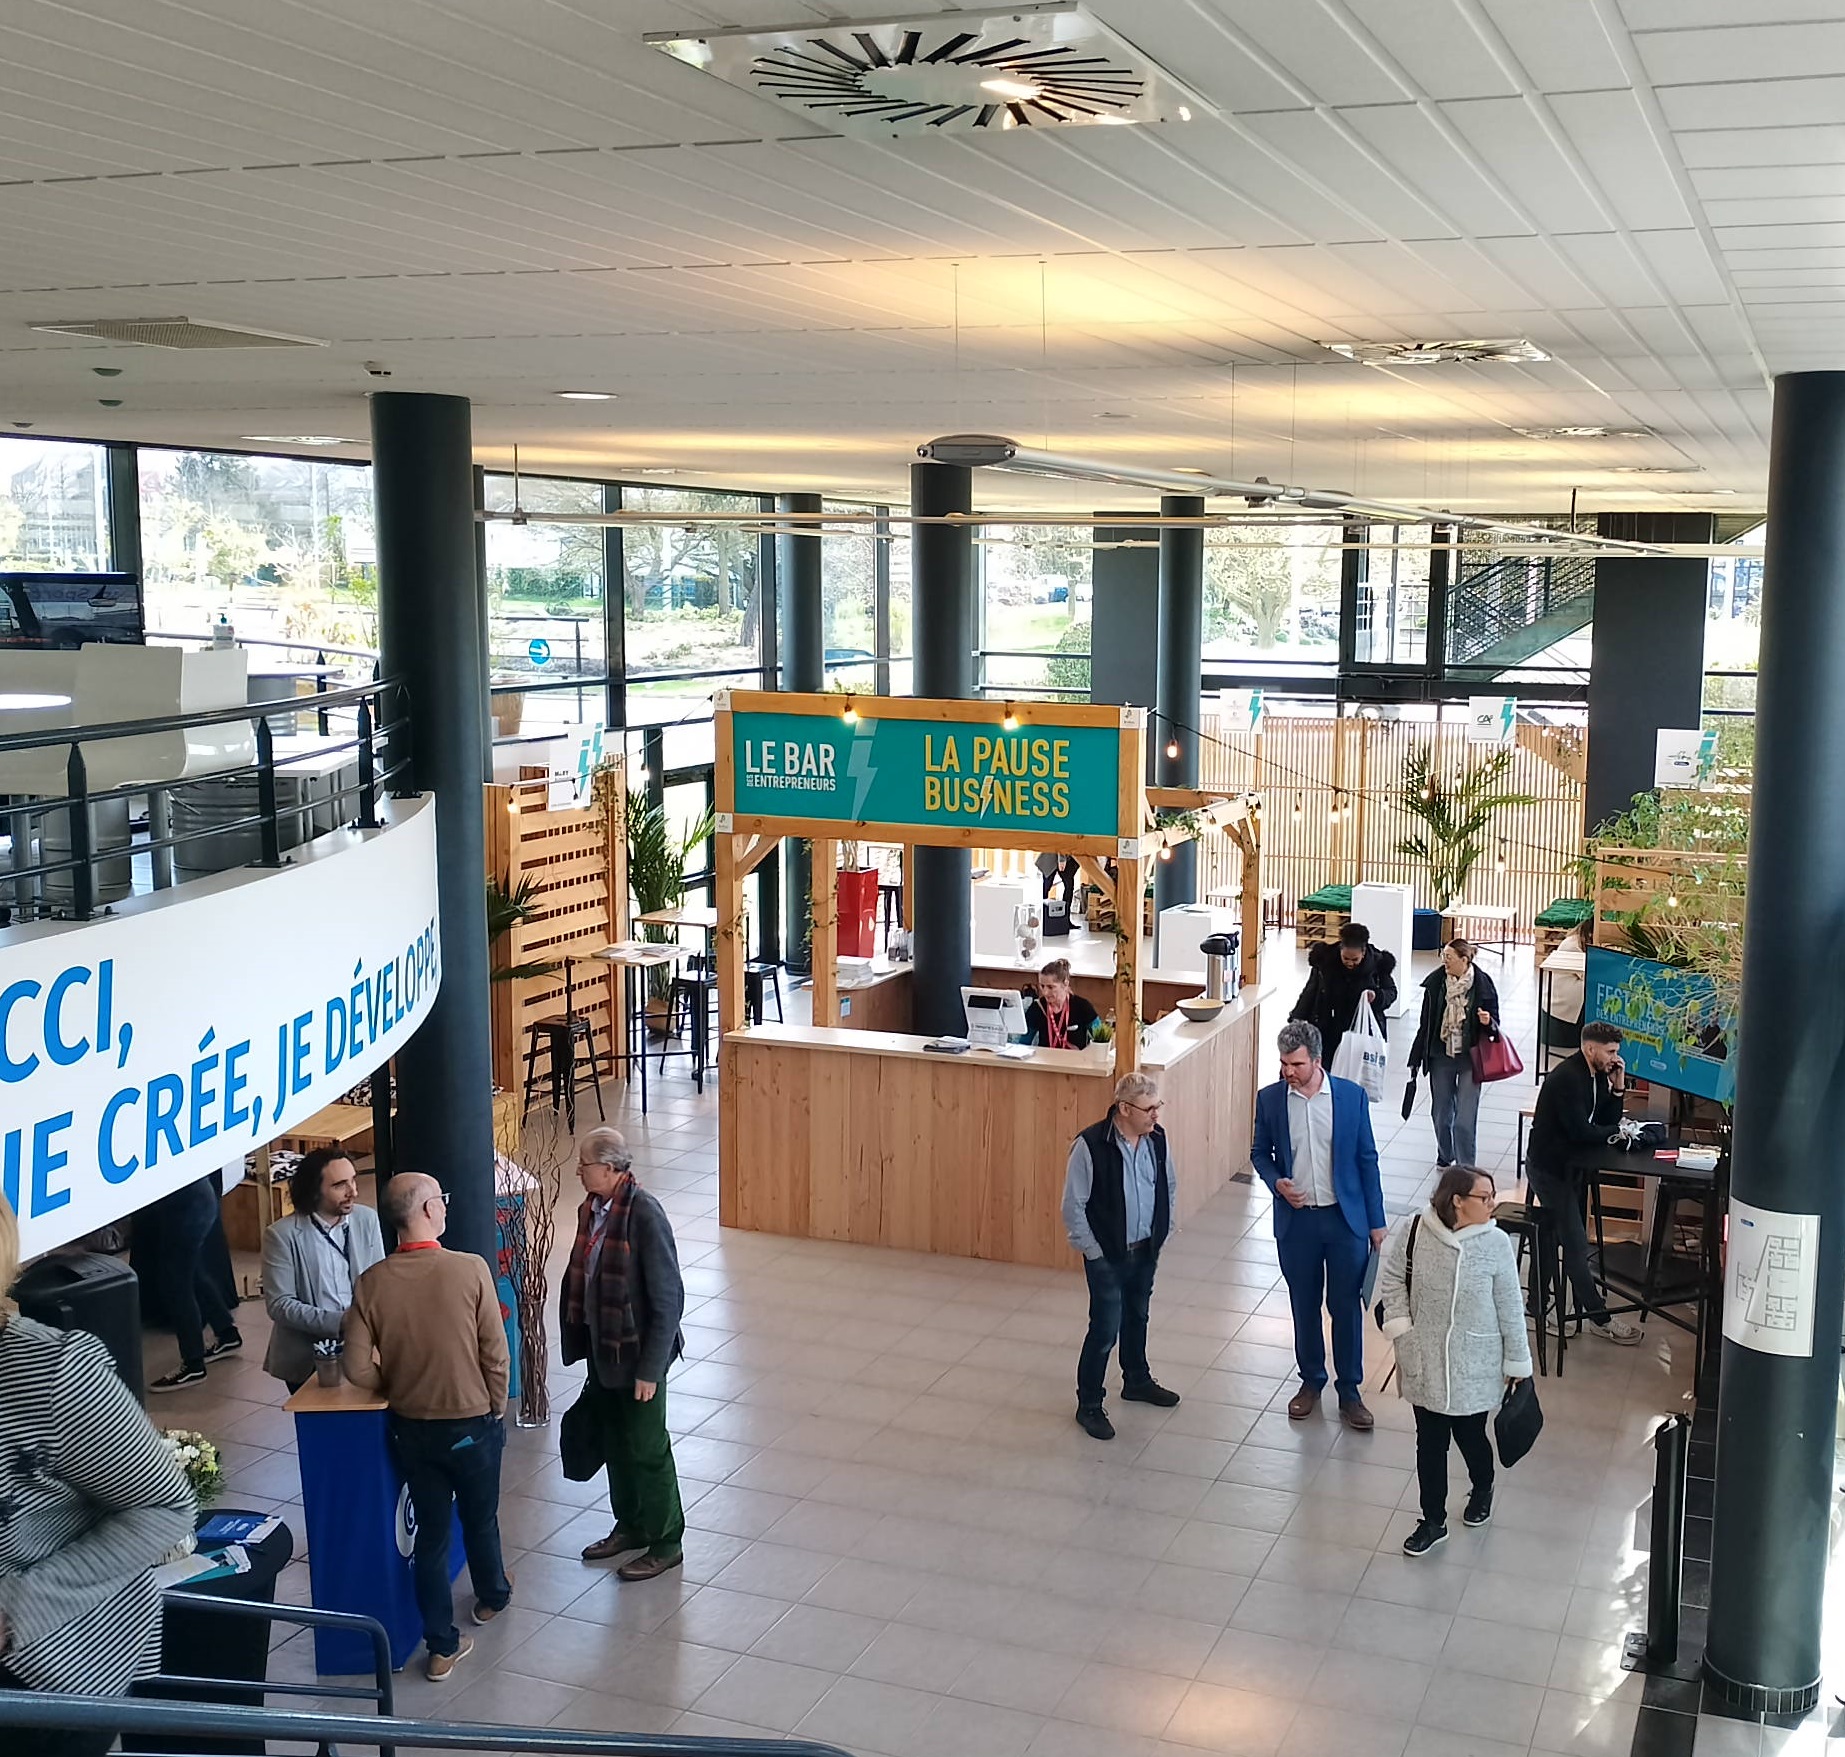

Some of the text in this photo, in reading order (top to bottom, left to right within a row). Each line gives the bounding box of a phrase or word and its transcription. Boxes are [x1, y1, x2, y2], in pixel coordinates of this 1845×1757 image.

[745, 740, 836, 777] LE BAR
[924, 734, 1070, 779] LA PAUSE
[746, 774, 836, 792] DES ENTREPRENEURS
[924, 775, 1070, 819] BUSINESS
[97, 1026, 262, 1185] CRÉE,
[272, 1010, 313, 1124] JE
